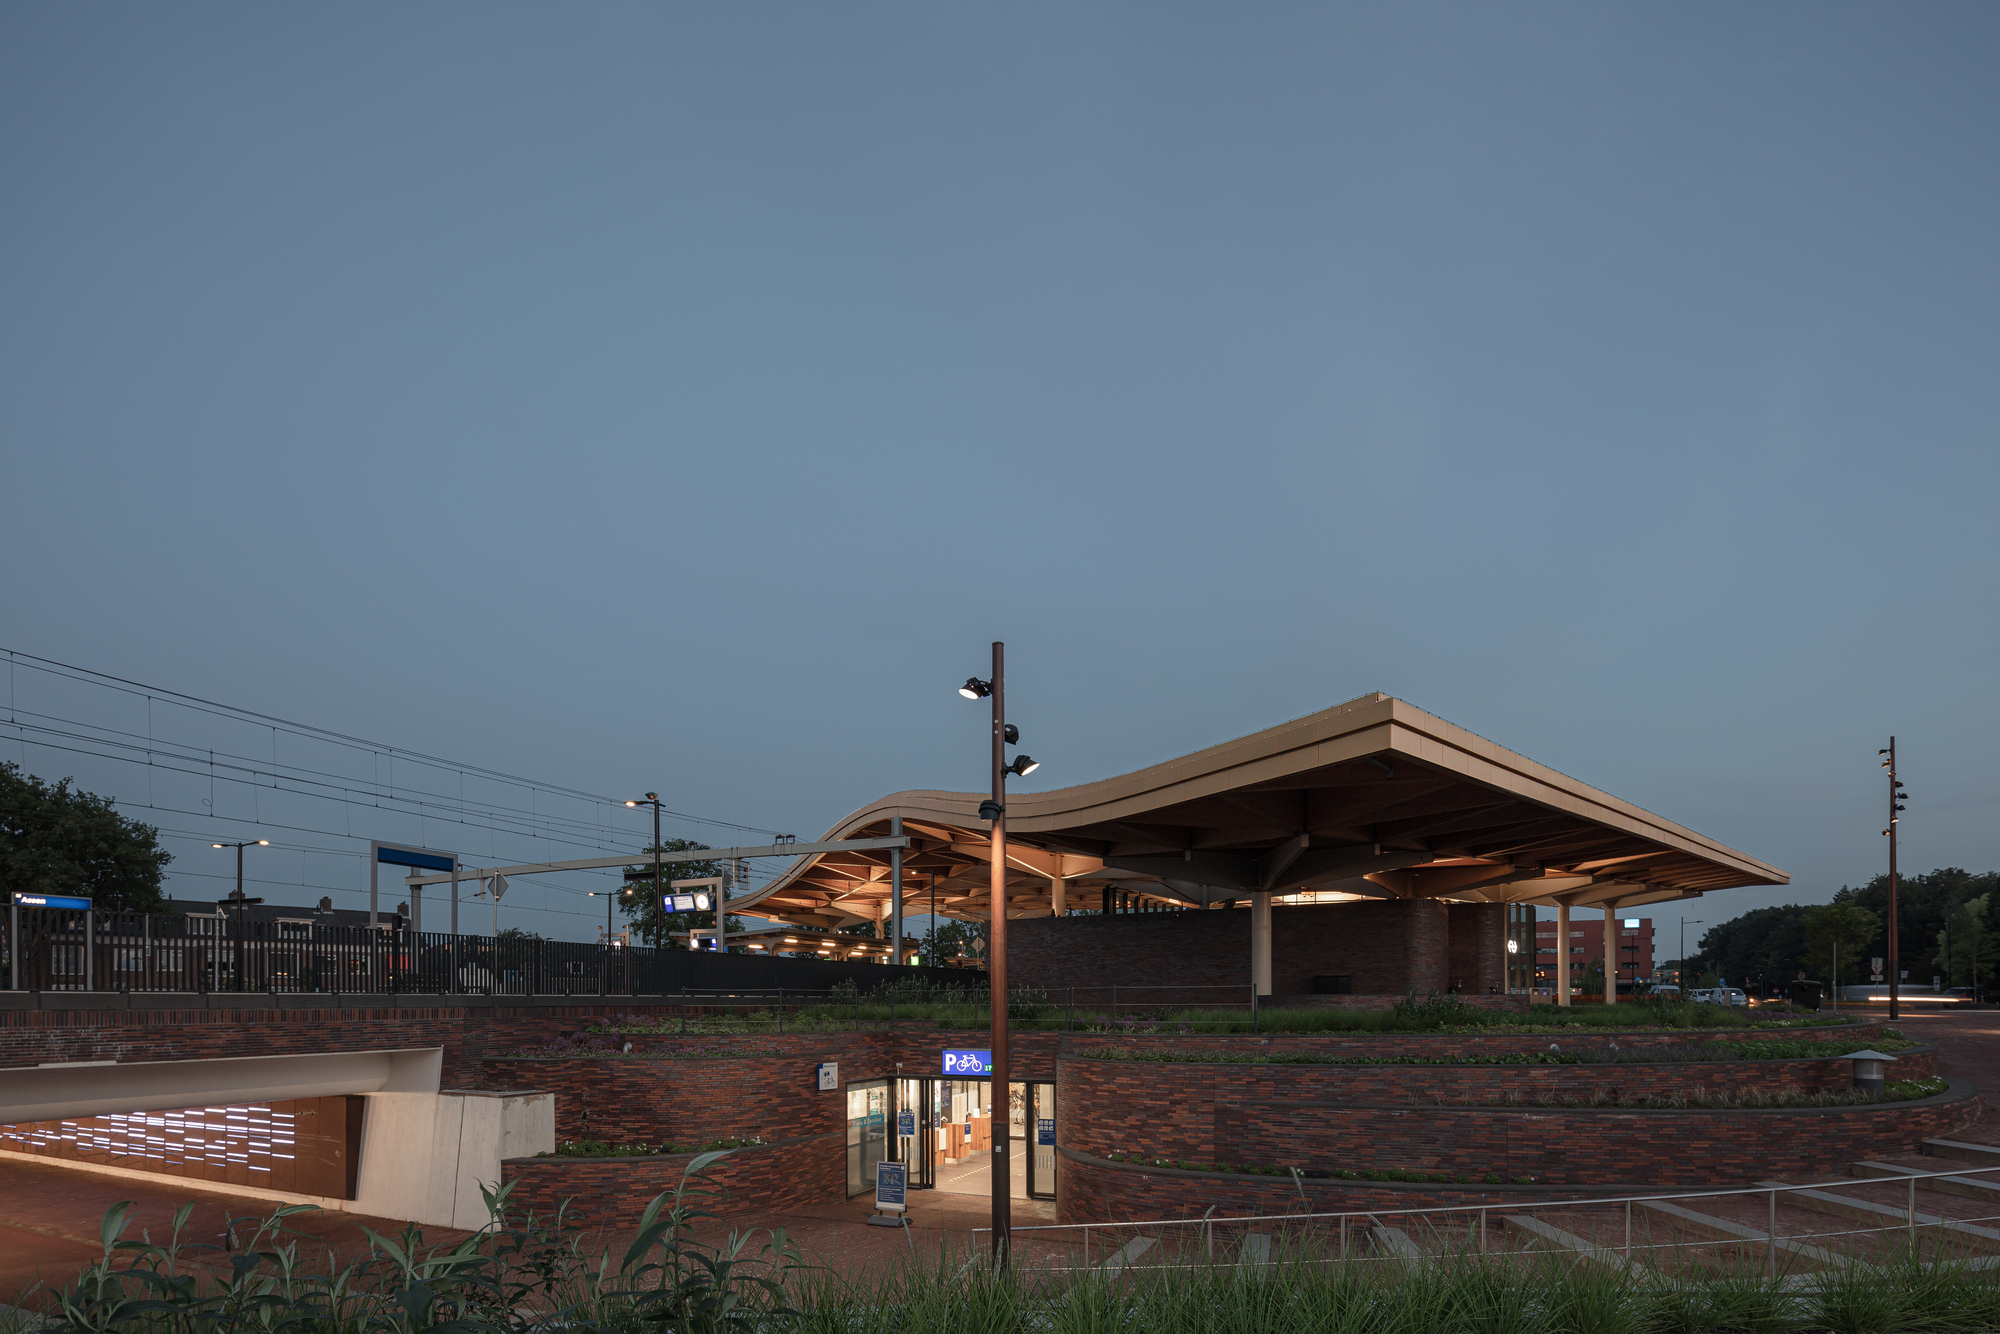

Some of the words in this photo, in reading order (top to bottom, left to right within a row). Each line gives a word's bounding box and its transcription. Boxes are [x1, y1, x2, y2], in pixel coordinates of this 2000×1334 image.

[20, 896, 47, 905] Assen
[945, 1053, 957, 1072] P
[867, 1117, 882, 1125] Service
